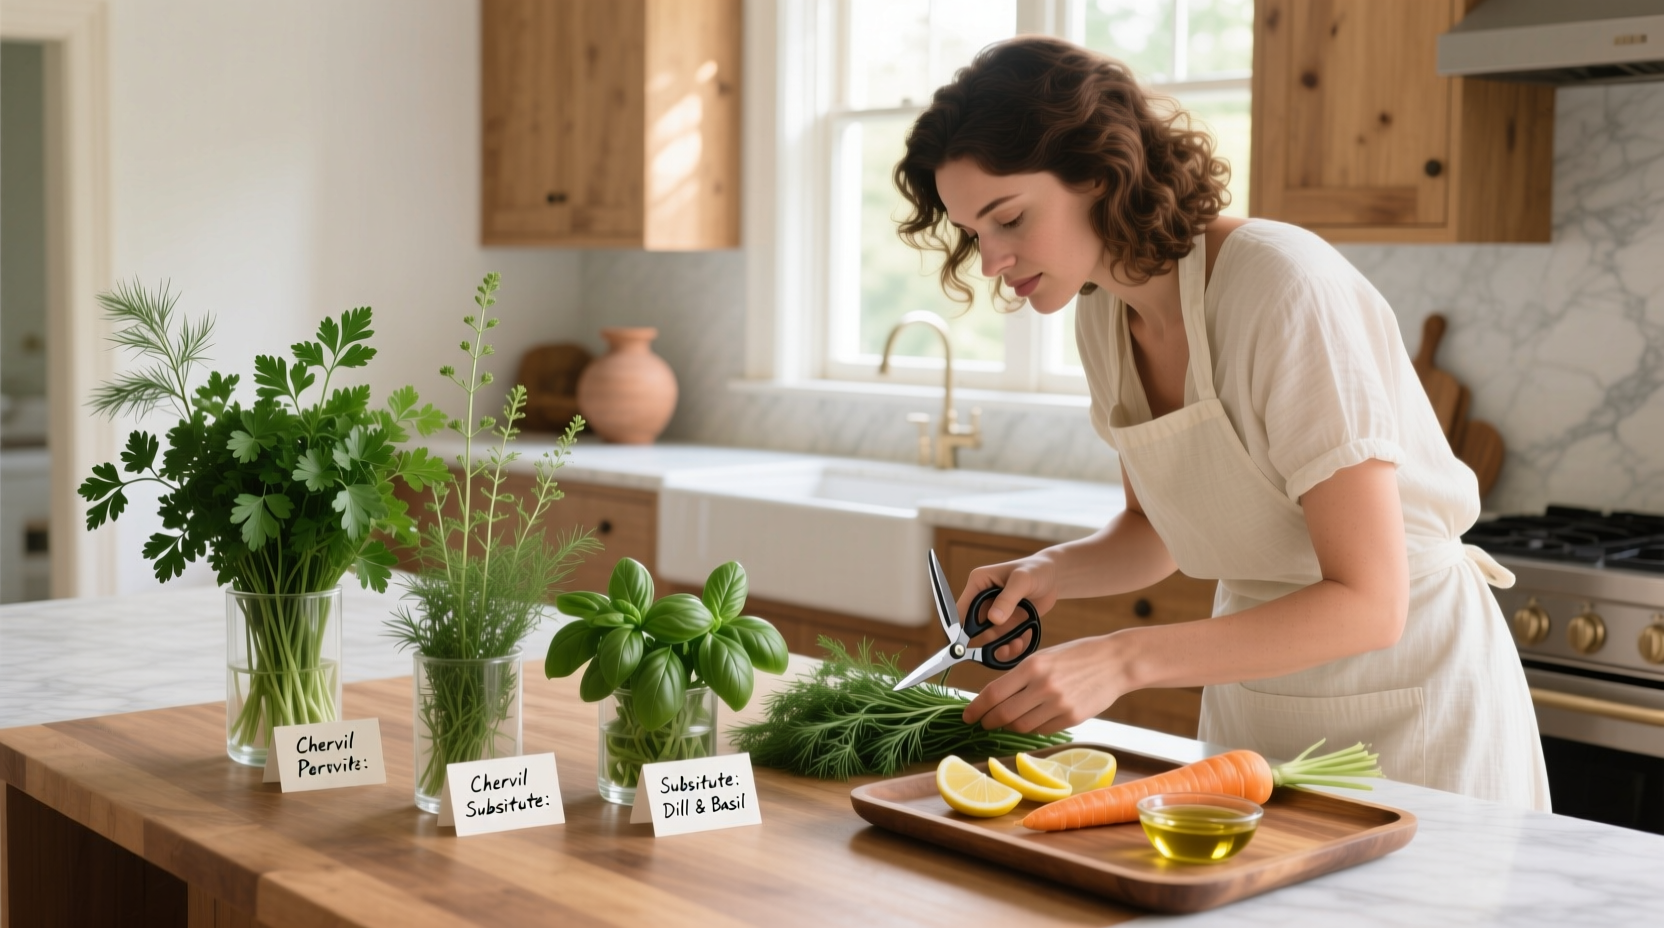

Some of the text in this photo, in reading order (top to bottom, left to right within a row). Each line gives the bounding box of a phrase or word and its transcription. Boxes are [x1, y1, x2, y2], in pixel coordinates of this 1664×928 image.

[296, 730, 354, 754] Chervil
[470, 767, 528, 793] Chervil
[660, 772, 739, 794] Subsitute:
[465, 792, 550, 818] Subsitute:
[662, 791, 745, 819] Dill & Basil
